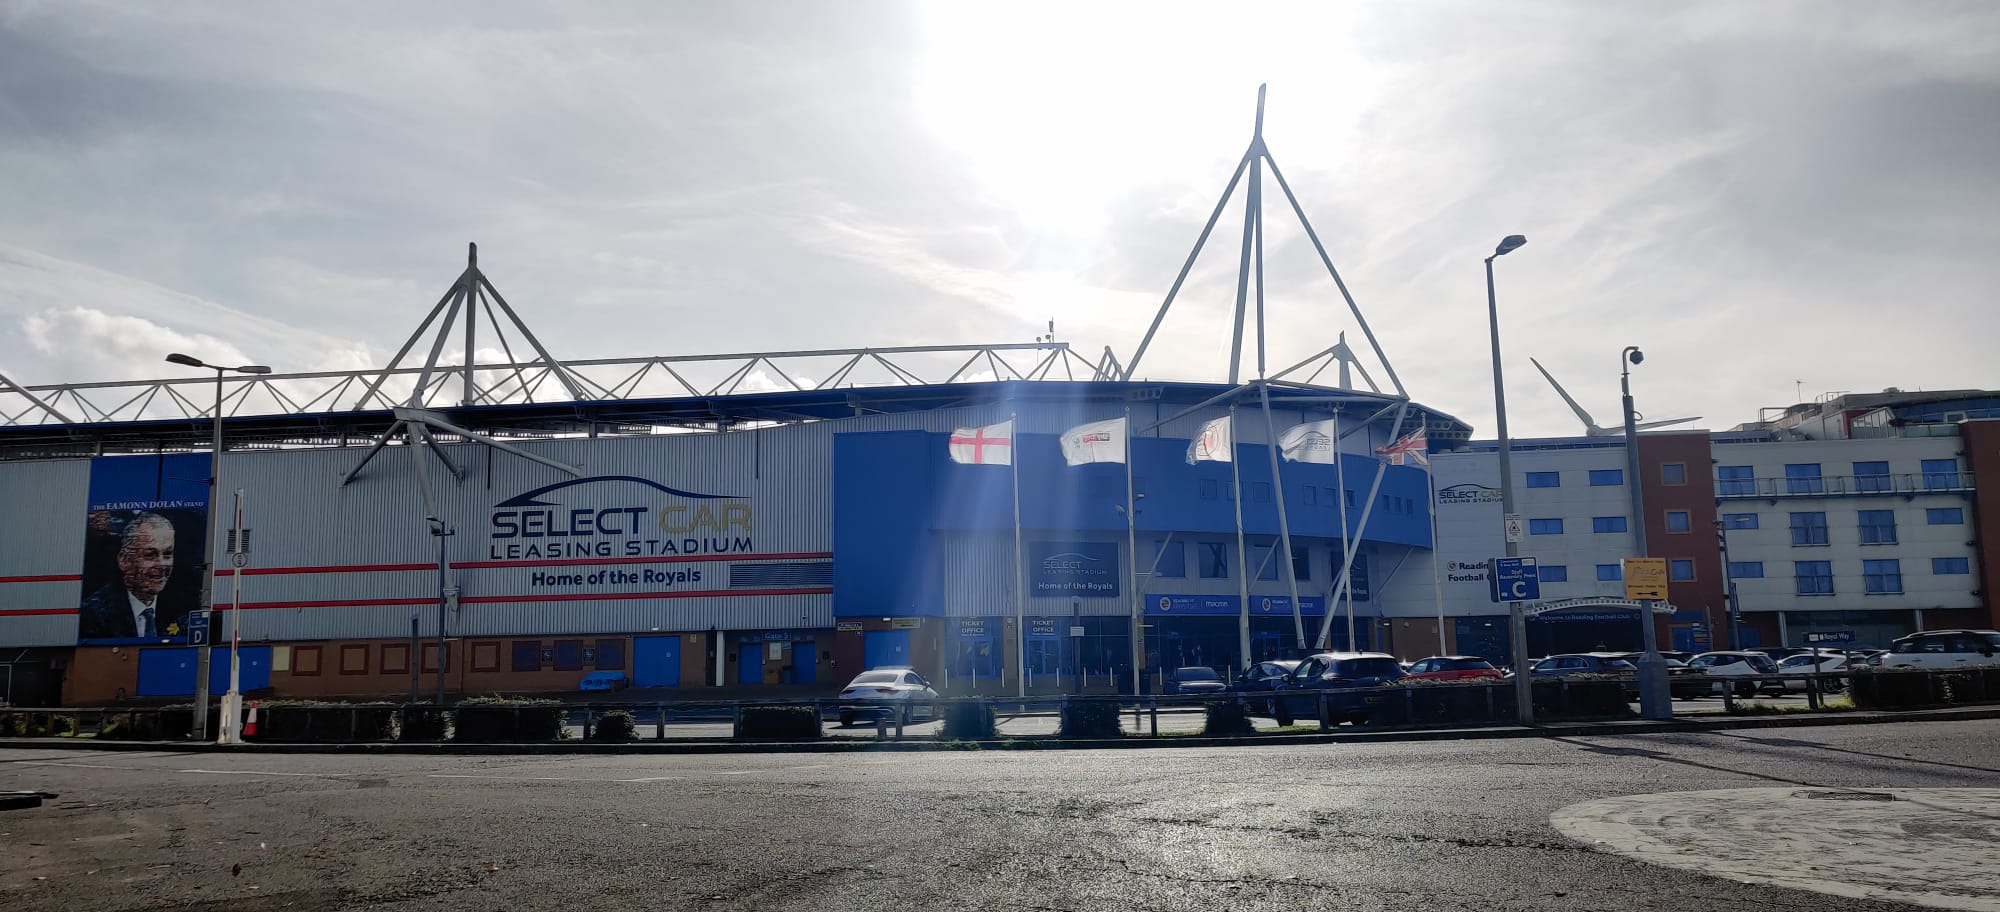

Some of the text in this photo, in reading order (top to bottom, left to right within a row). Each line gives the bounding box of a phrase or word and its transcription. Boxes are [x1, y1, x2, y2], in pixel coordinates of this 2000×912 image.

[1439, 490, 1478, 499] SELECT
[106, 501, 147, 510] EAMONN
[149, 500, 183, 509] DOLAN
[491, 503, 752, 539] SELECT CAR
[490, 537, 753, 560] LEASING STADIUM
[1043, 561, 1081, 569] SELECT
[1459, 562, 1489, 570] Readin
[531, 568, 701, 587] Home of the Royals
[1448, 573, 1484, 581] Football
[1038, 581, 1113, 592] Home of the Royals
[1511, 580, 1527, 598] C
[194, 630, 202, 643] D
[1839, 631, 1849, 641] Way
